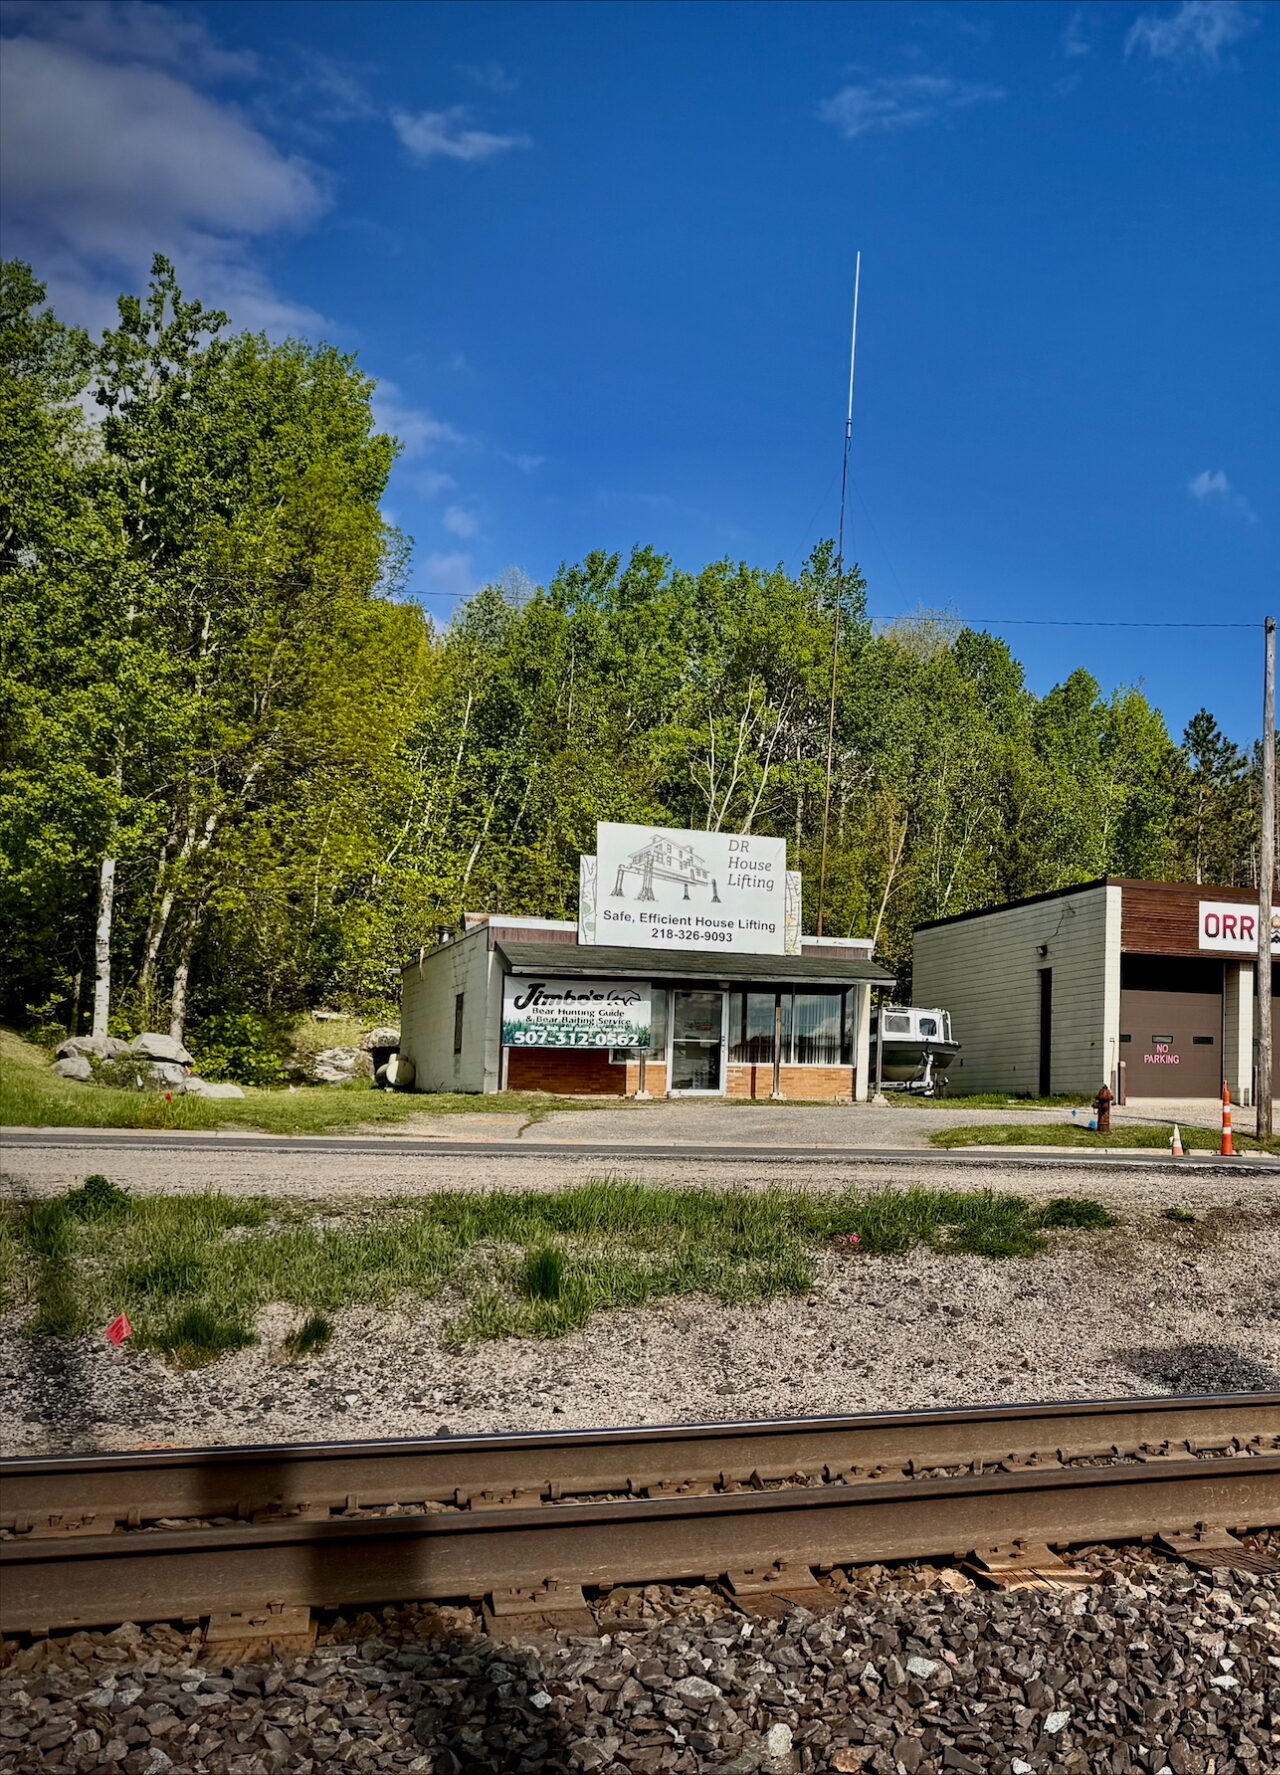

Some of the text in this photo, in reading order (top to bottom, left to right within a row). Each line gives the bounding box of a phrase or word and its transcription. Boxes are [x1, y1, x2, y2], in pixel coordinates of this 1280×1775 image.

[728, 839, 750, 853] DR
[728, 856, 772, 872] House
[728, 873, 775, 892] Lifting
[603, 910, 776, 934] Safe, Efficient House Lifting
[1204, 912, 1255, 941] ORR
[651, 927, 733, 943] 218-326-9093
[513, 982, 605, 1010] Jimbo's
[532, 1006, 625, 1018] Bear Hunting Guide
[536, 1015, 559, 1023] Bear
[598, 1017, 632, 1026] Service
[513, 1031, 640, 1047] 507-312-0562
[1156, 1044, 1169, 1054] NO
[1144, 1054, 1180, 1065] PARKING
